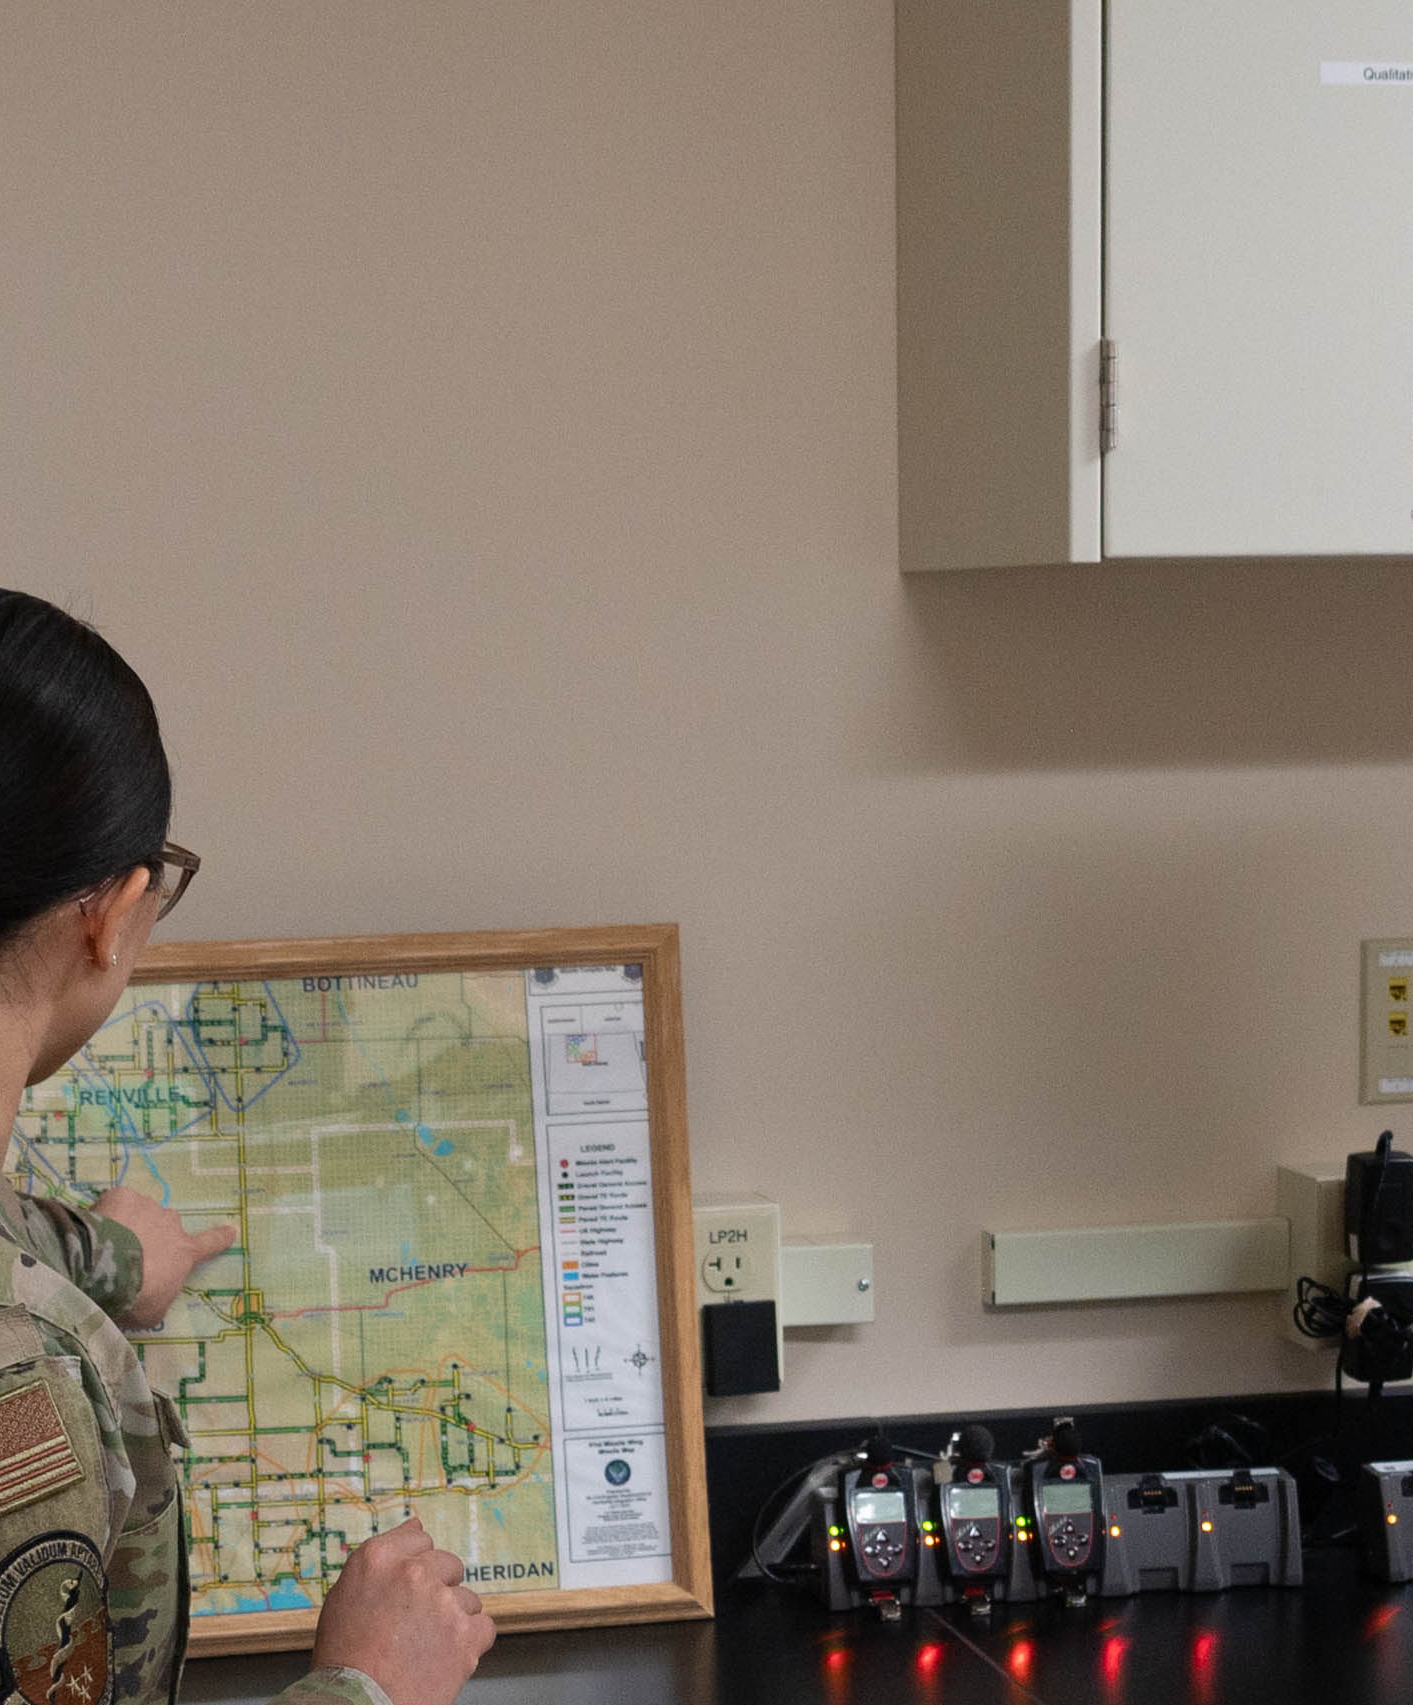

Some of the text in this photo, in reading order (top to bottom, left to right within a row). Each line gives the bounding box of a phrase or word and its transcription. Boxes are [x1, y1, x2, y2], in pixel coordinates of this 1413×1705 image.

[303, 973, 418, 992] BOTTINEAU
[80, 1086, 181, 1105] RENVILLE
[709, 1229, 748, 1244] LP2H
[369, 1263, 468, 1284] MCHENRY
[13, 1542, 68, 1578] VALIDUM
[463, 1562, 554, 1582] HERIDAN
